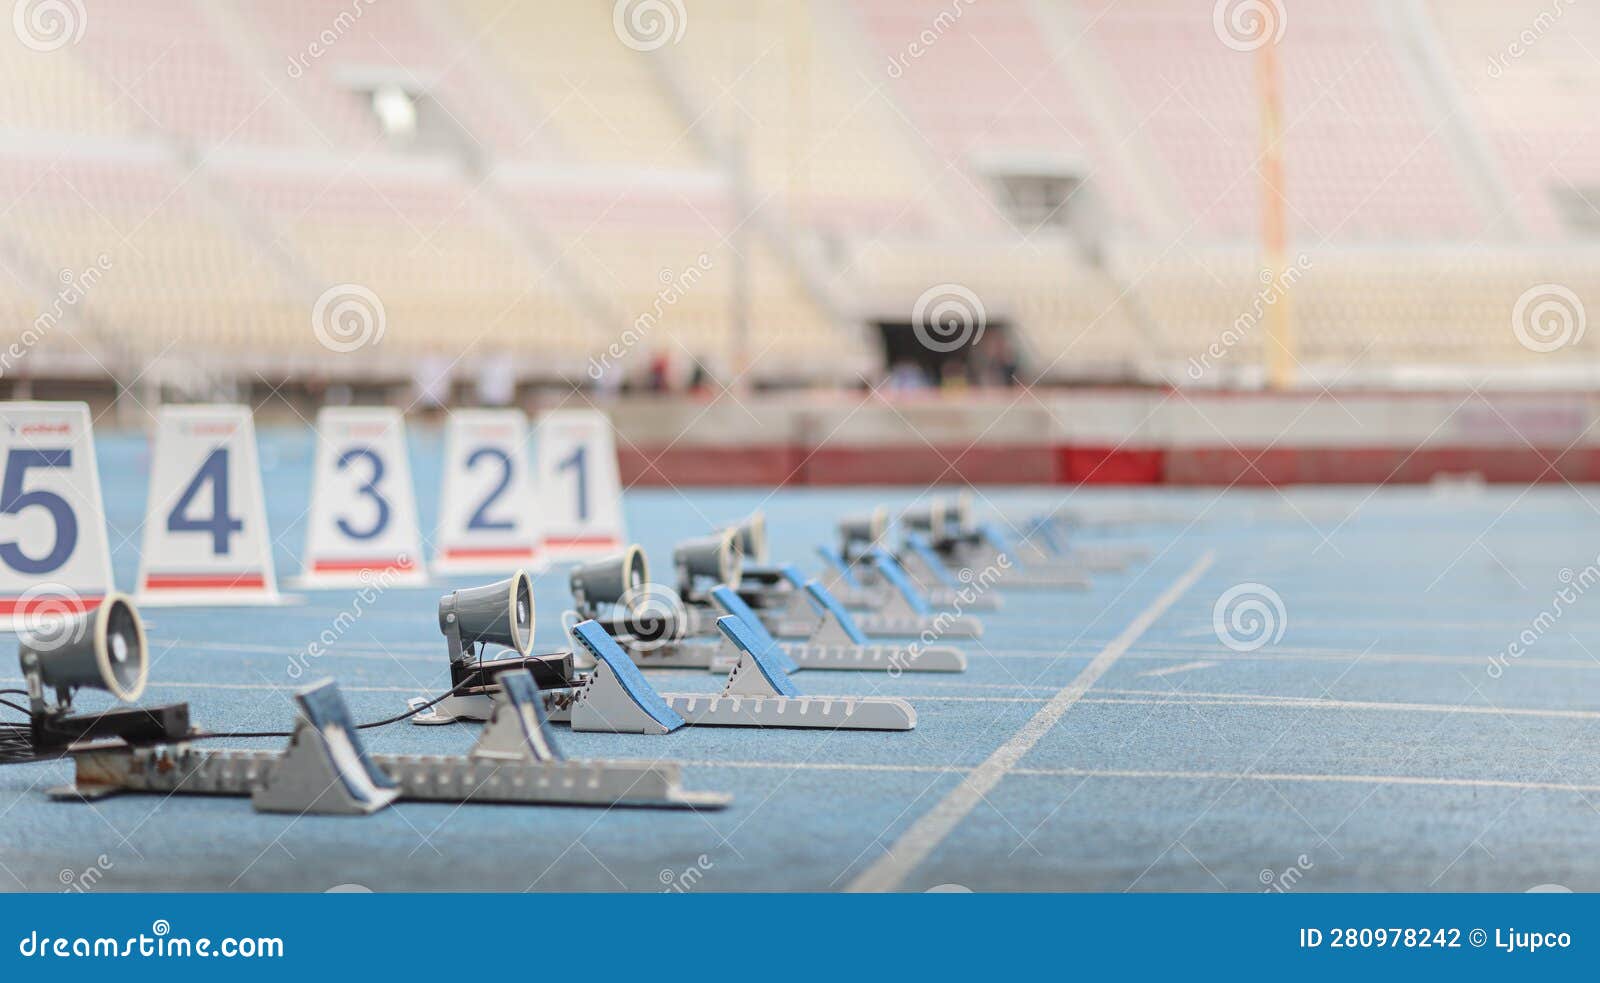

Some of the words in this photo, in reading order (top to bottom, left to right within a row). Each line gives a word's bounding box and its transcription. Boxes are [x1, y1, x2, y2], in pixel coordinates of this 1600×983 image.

[0, 449, 78, 574] 5
[167, 449, 243, 555] 4
[336, 448, 390, 541] 3
[466, 448, 514, 530] 2
[556, 448, 588, 521] 1
